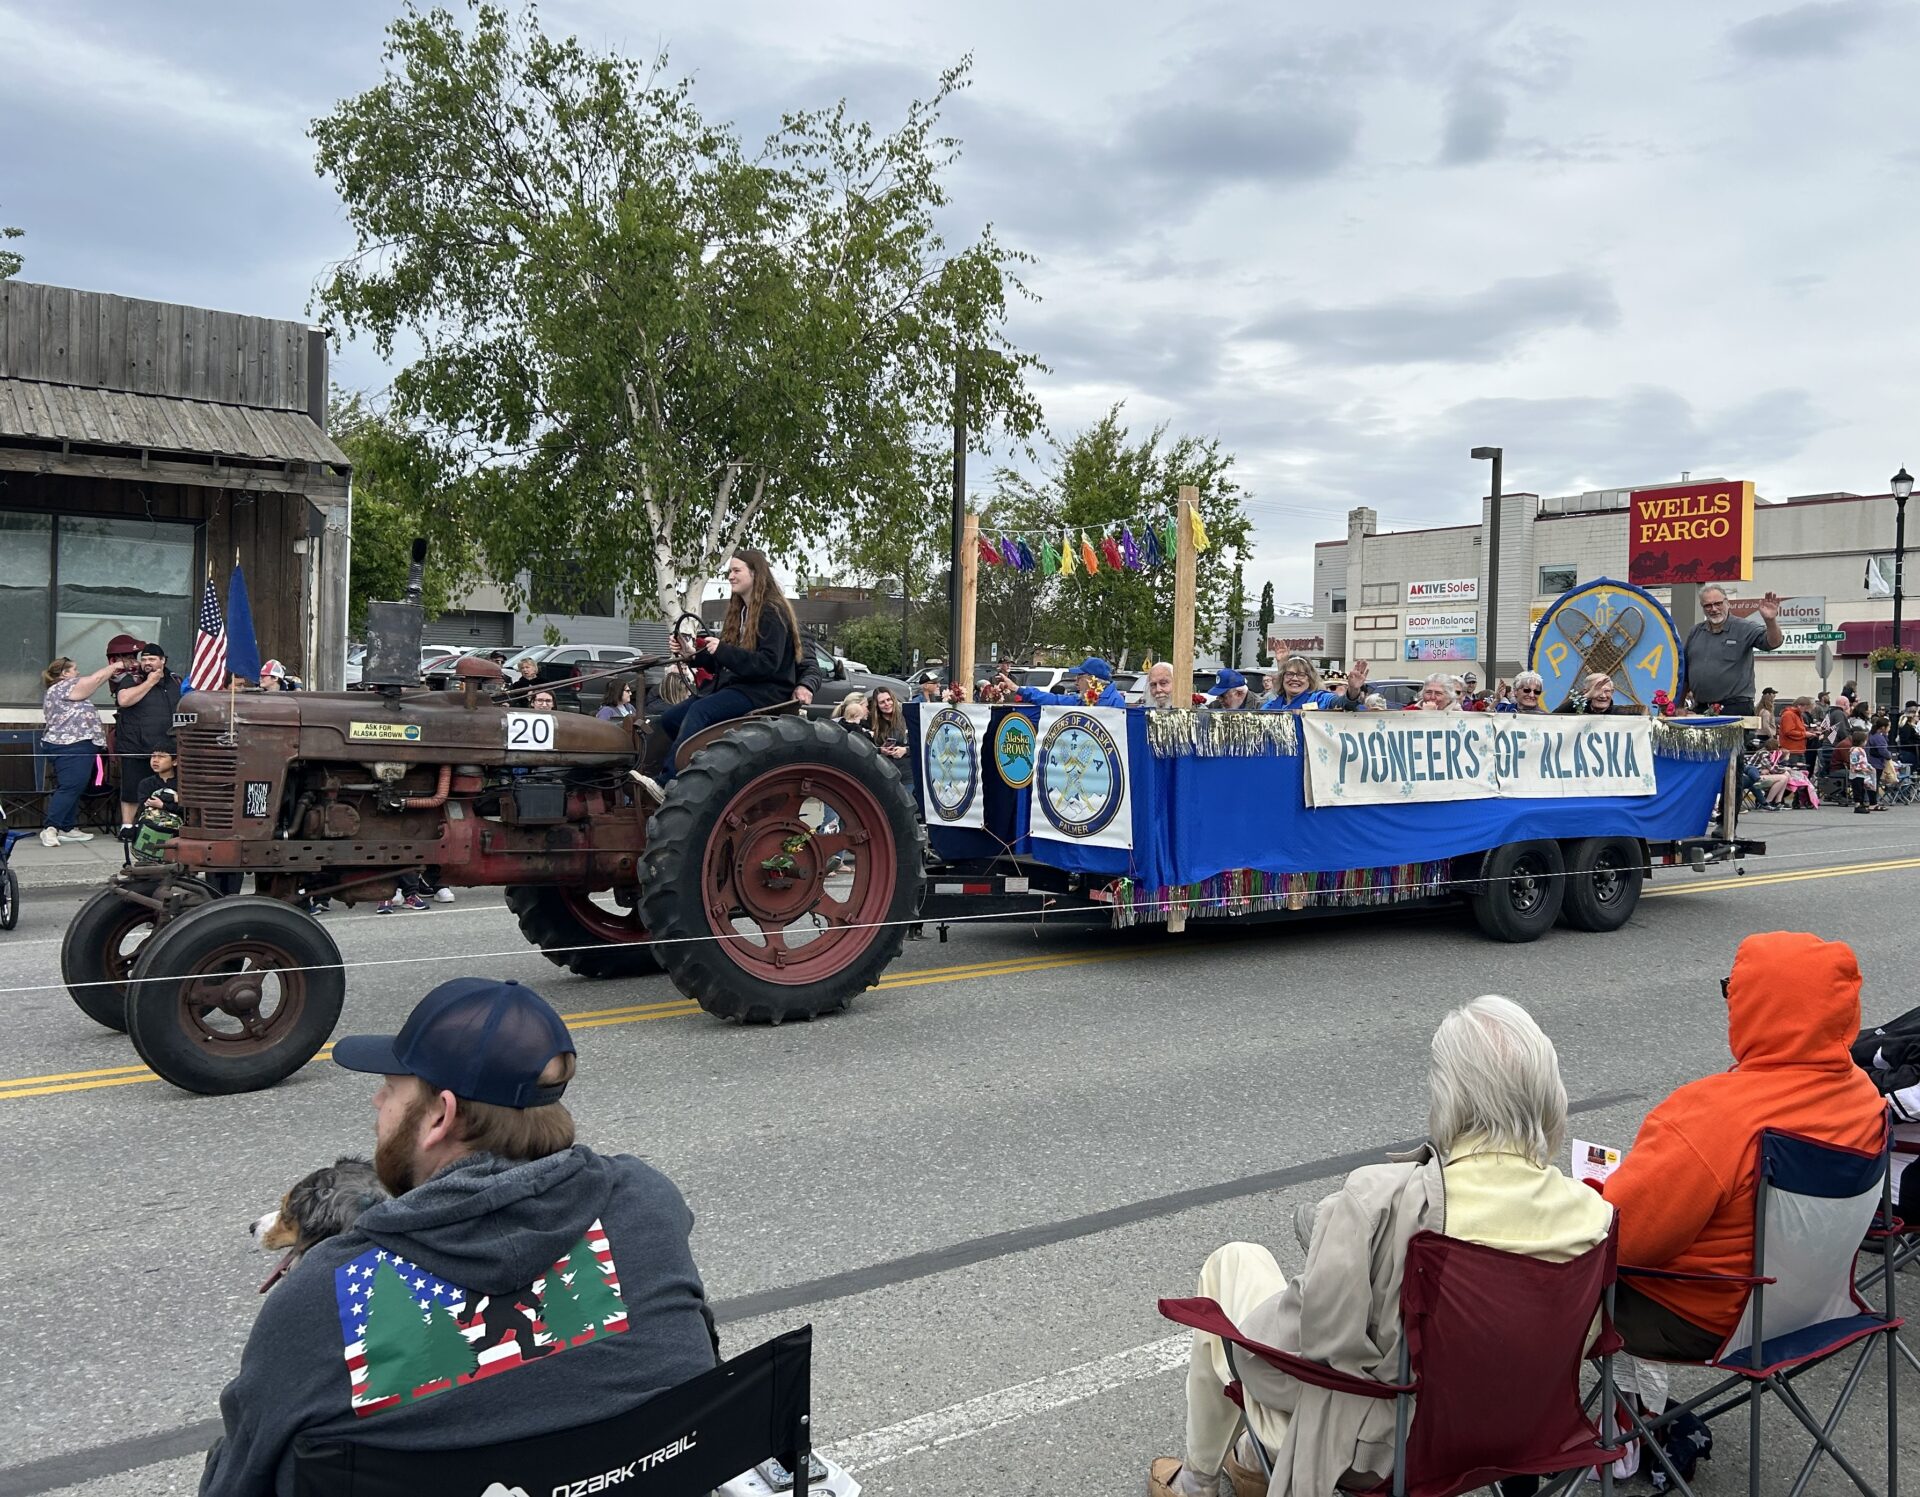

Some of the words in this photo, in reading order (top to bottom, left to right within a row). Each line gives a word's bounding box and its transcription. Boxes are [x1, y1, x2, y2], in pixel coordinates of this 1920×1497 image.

[1638, 493, 1730, 520] WELLS
[1640, 518, 1730, 543] FARGO
[1410, 583, 1446, 595] AKTIVE
[1447, 581, 1475, 593] Soles
[1595, 606, 1615, 626] OF
[1776, 605, 1820, 617] lutions
[1408, 617, 1431, 626] BODY
[1432, 617, 1440, 625] In
[1441, 615, 1475, 625] Balance
[1424, 639, 1455, 649] PALMER
[1432, 649, 1447, 659] SPA
[1545, 642, 1569, 678] P
[1636, 644, 1664, 679] A
[511, 718, 550, 744] 20
[1006, 731, 1030, 744] Alaska
[1071, 715, 1082, 726] OF
[1084, 720, 1114, 755] ALASKA
[1001, 743, 1031, 756] GROWN
[1339, 730, 1480, 784] PIONEERS
[1494, 731, 1527, 779] OF
[1540, 731, 1641, 779] ALASKA
[1093, 758, 1104, 772] A
[247, 783, 268, 794] MOON
[247, 792, 267, 804] STONE
[247, 802, 267, 814] FARM
[1058, 820, 1089, 835] PALMER
